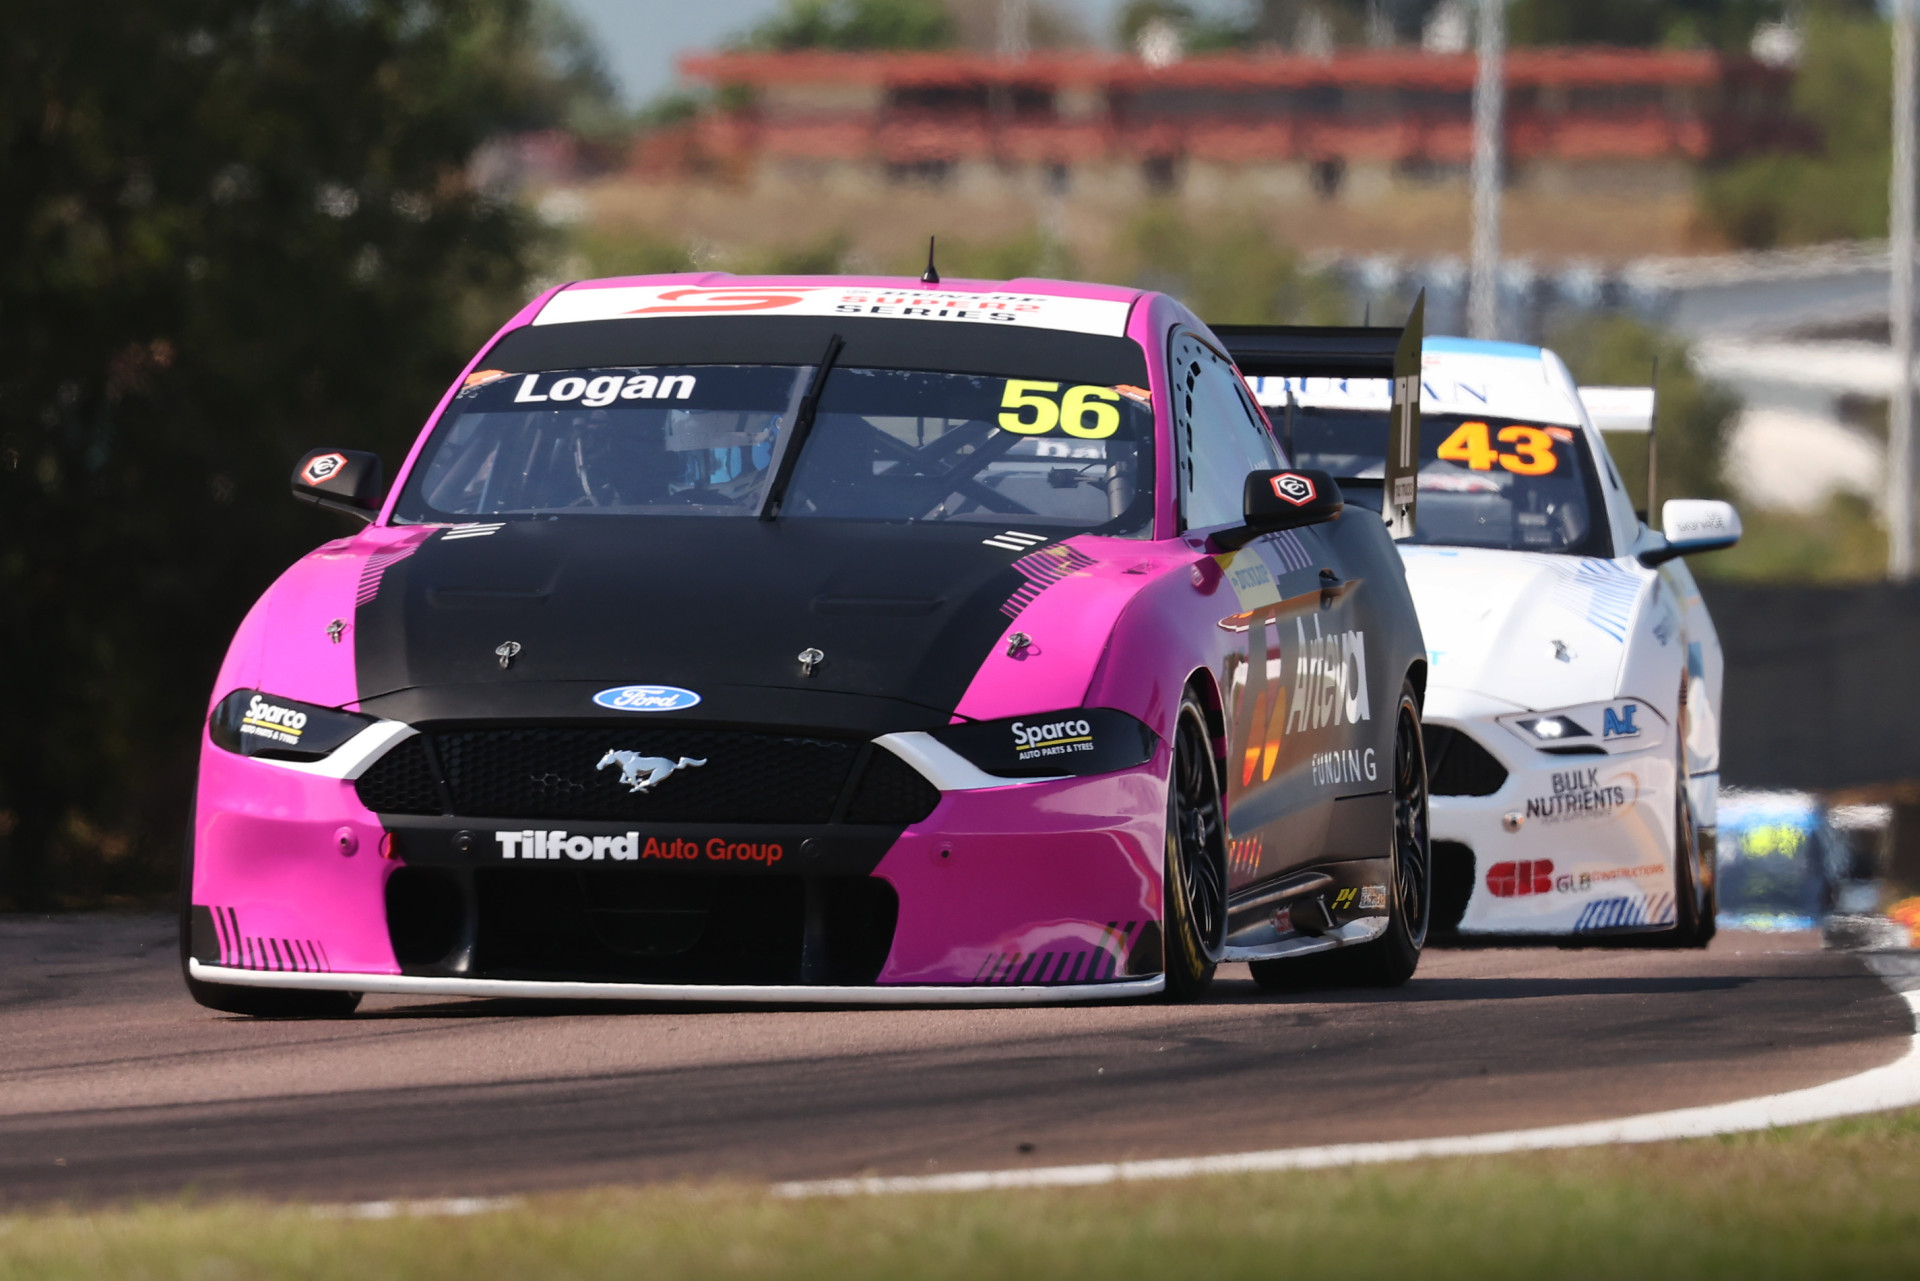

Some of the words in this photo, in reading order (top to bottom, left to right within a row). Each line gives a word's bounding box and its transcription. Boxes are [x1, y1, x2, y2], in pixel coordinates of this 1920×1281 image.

[835, 305, 1016, 321] SERIES
[841, 296, 1040, 313] SUPER2
[513, 374, 697, 407] Logan
[998, 379, 1120, 439] 56
[1437, 421, 1557, 476] 43
[1285, 613, 1371, 735] Arteva
[245, 694, 307, 729] Sparco
[613, 689, 680, 707] Ford
[1011, 720, 1090, 748] Sparco
[1019, 750, 1041, 760] AUTO
[1042, 746, 1065, 757] PARTS
[1066, 744, 1073, 752] &
[1073, 742, 1094, 751] TYRES
[1311, 747, 1377, 787] FUNDING
[1551, 767, 1600, 794] BULK
[1526, 786, 1625, 818] NUTRIENTS
[495, 830, 639, 861] Tilford
[642, 837, 698, 859] Auto
[705, 838, 783, 866] Group
